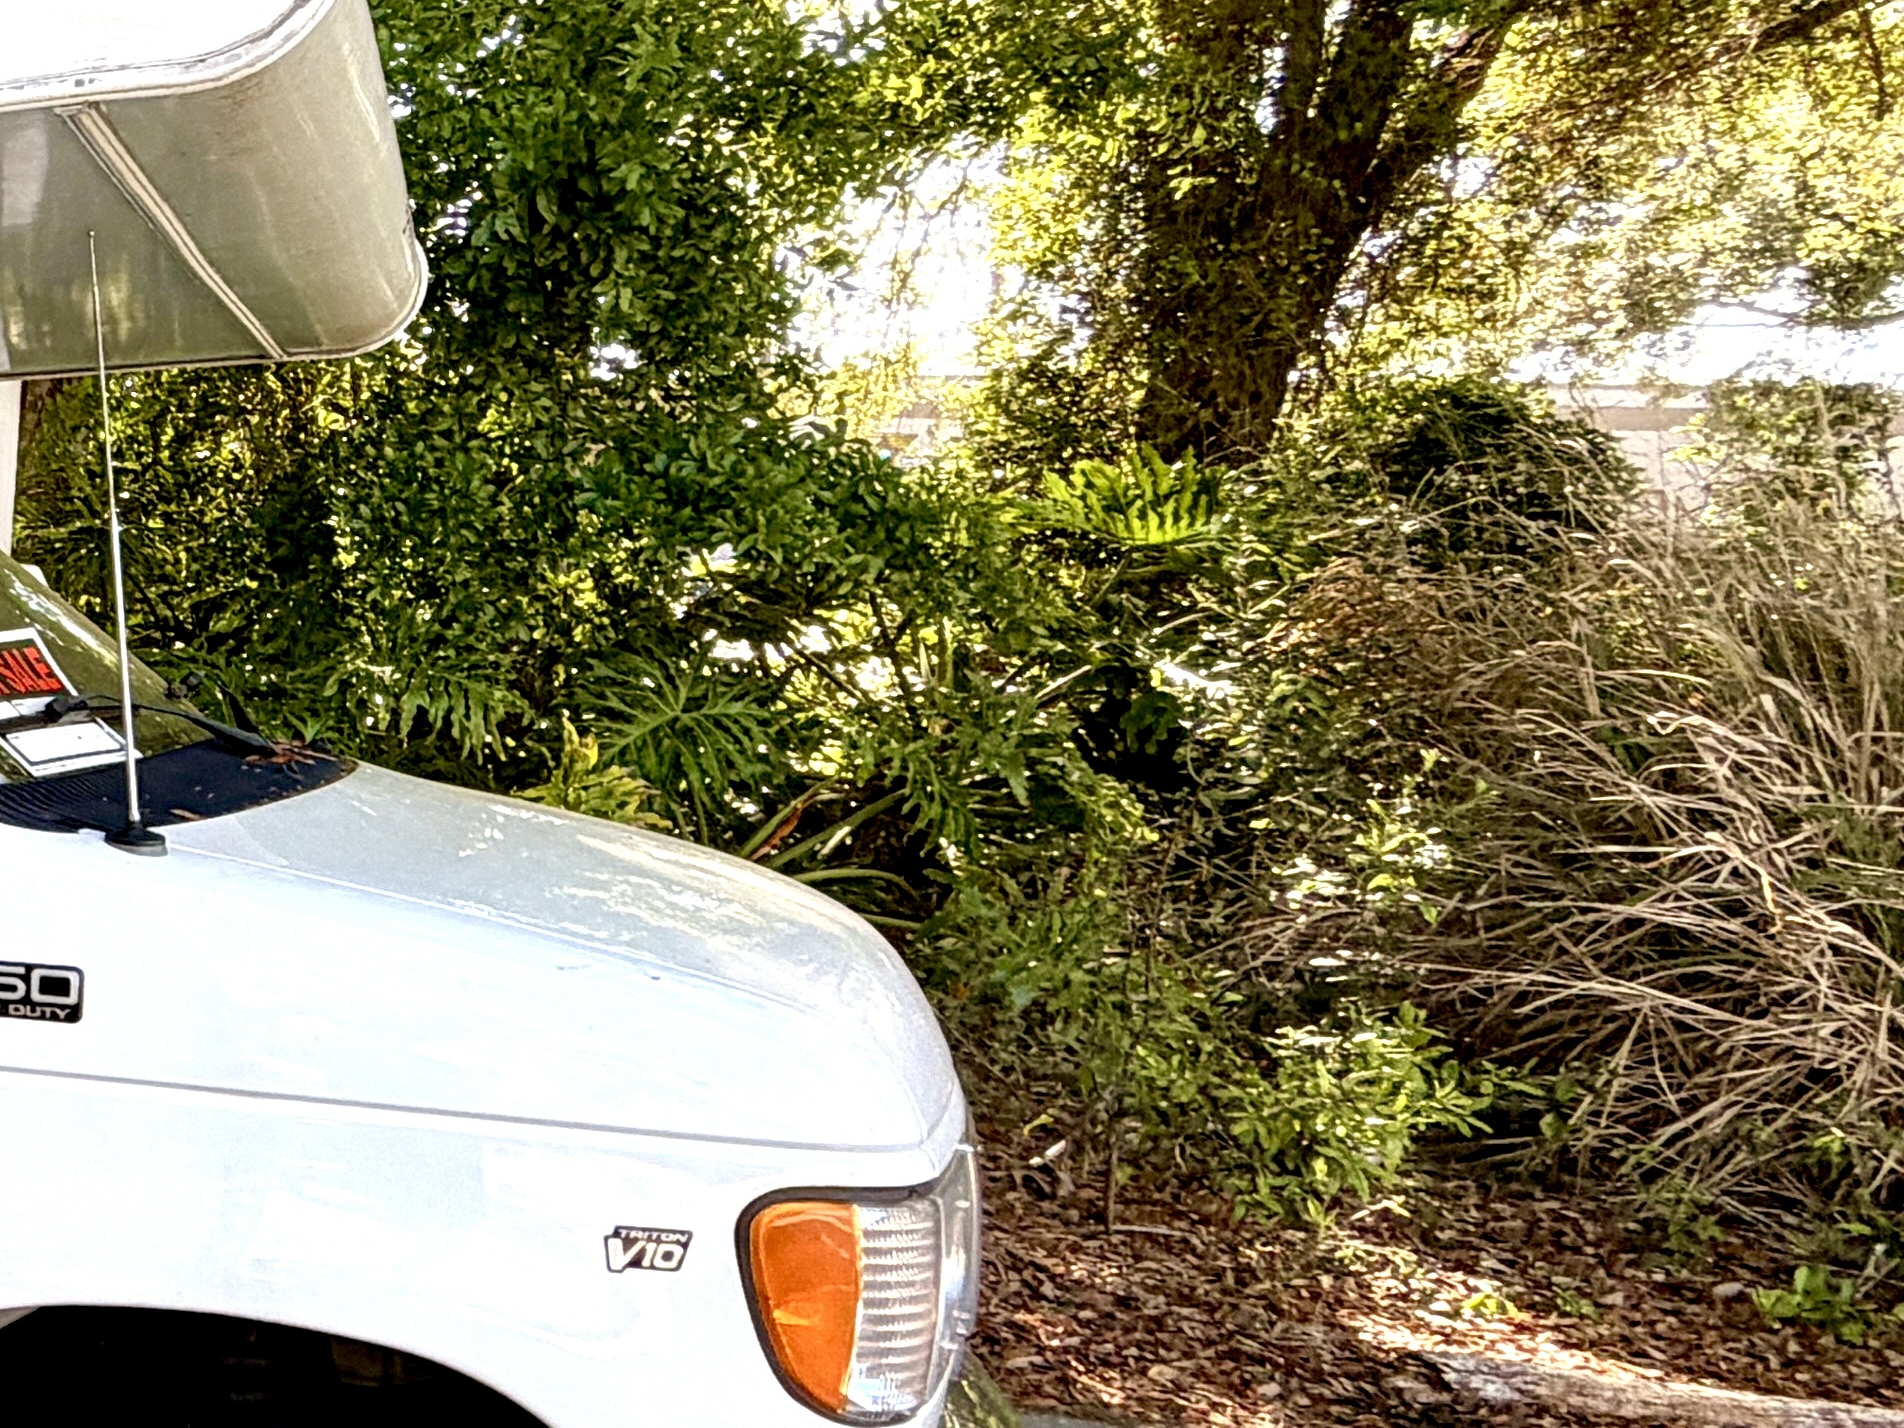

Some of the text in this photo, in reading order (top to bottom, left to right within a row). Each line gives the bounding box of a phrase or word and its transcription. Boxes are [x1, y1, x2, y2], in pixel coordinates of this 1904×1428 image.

[8, 1003, 72, 1021] DUTY
[617, 1228, 689, 1243] TRITON
[607, 1237, 685, 1271] V10
